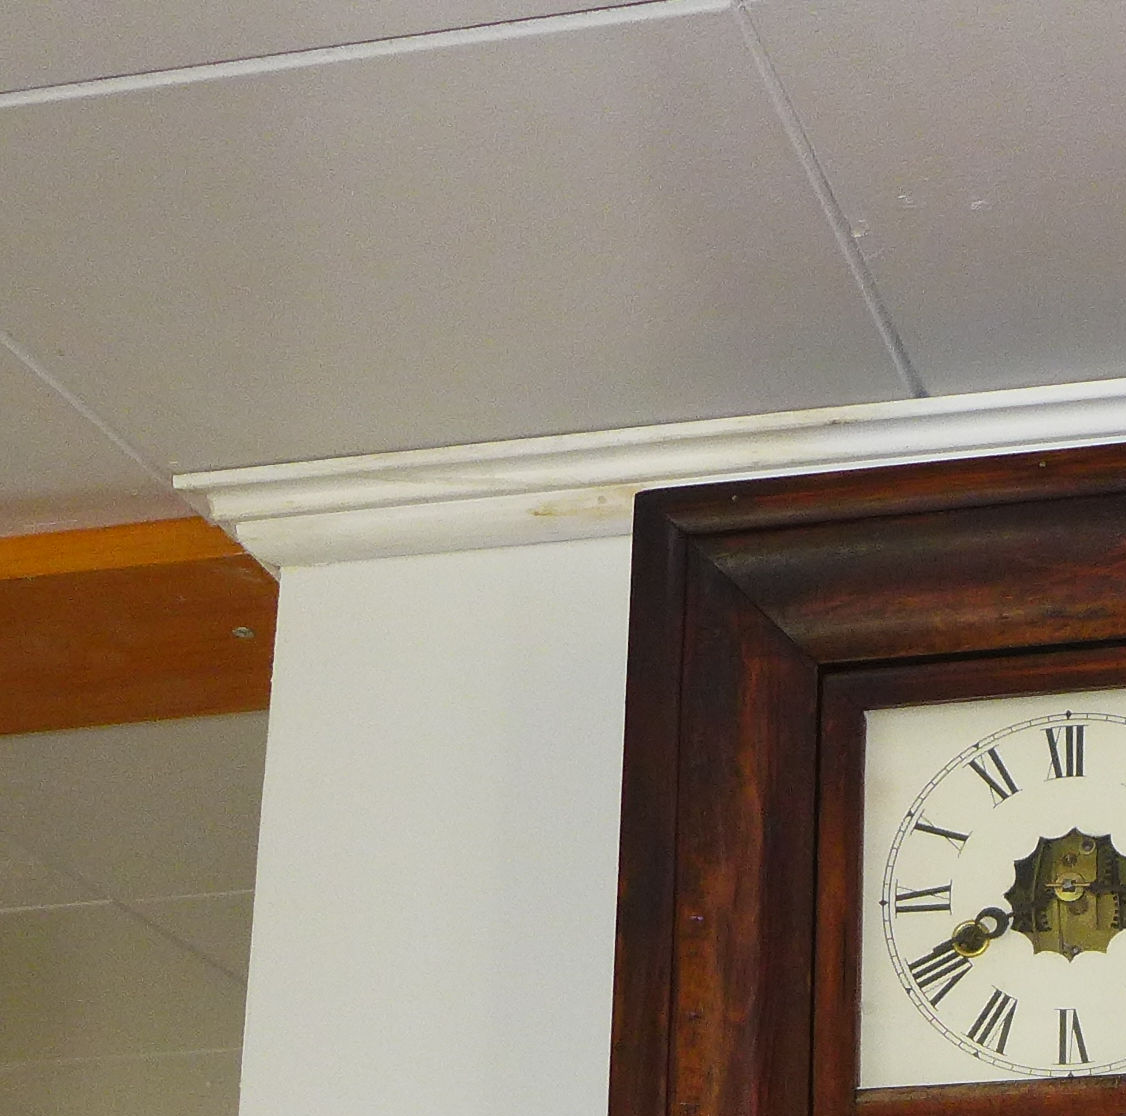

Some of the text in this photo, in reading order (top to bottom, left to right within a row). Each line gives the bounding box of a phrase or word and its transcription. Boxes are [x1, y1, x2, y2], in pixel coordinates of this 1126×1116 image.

[962, 745, 1023, 808] XI
[1041, 724, 1088, 781] XII
[910, 810, 973, 857] X
[894, 879, 953, 918] IX
[962, 985, 1018, 1056] VII
[1053, 1008, 1095, 1065] VI
